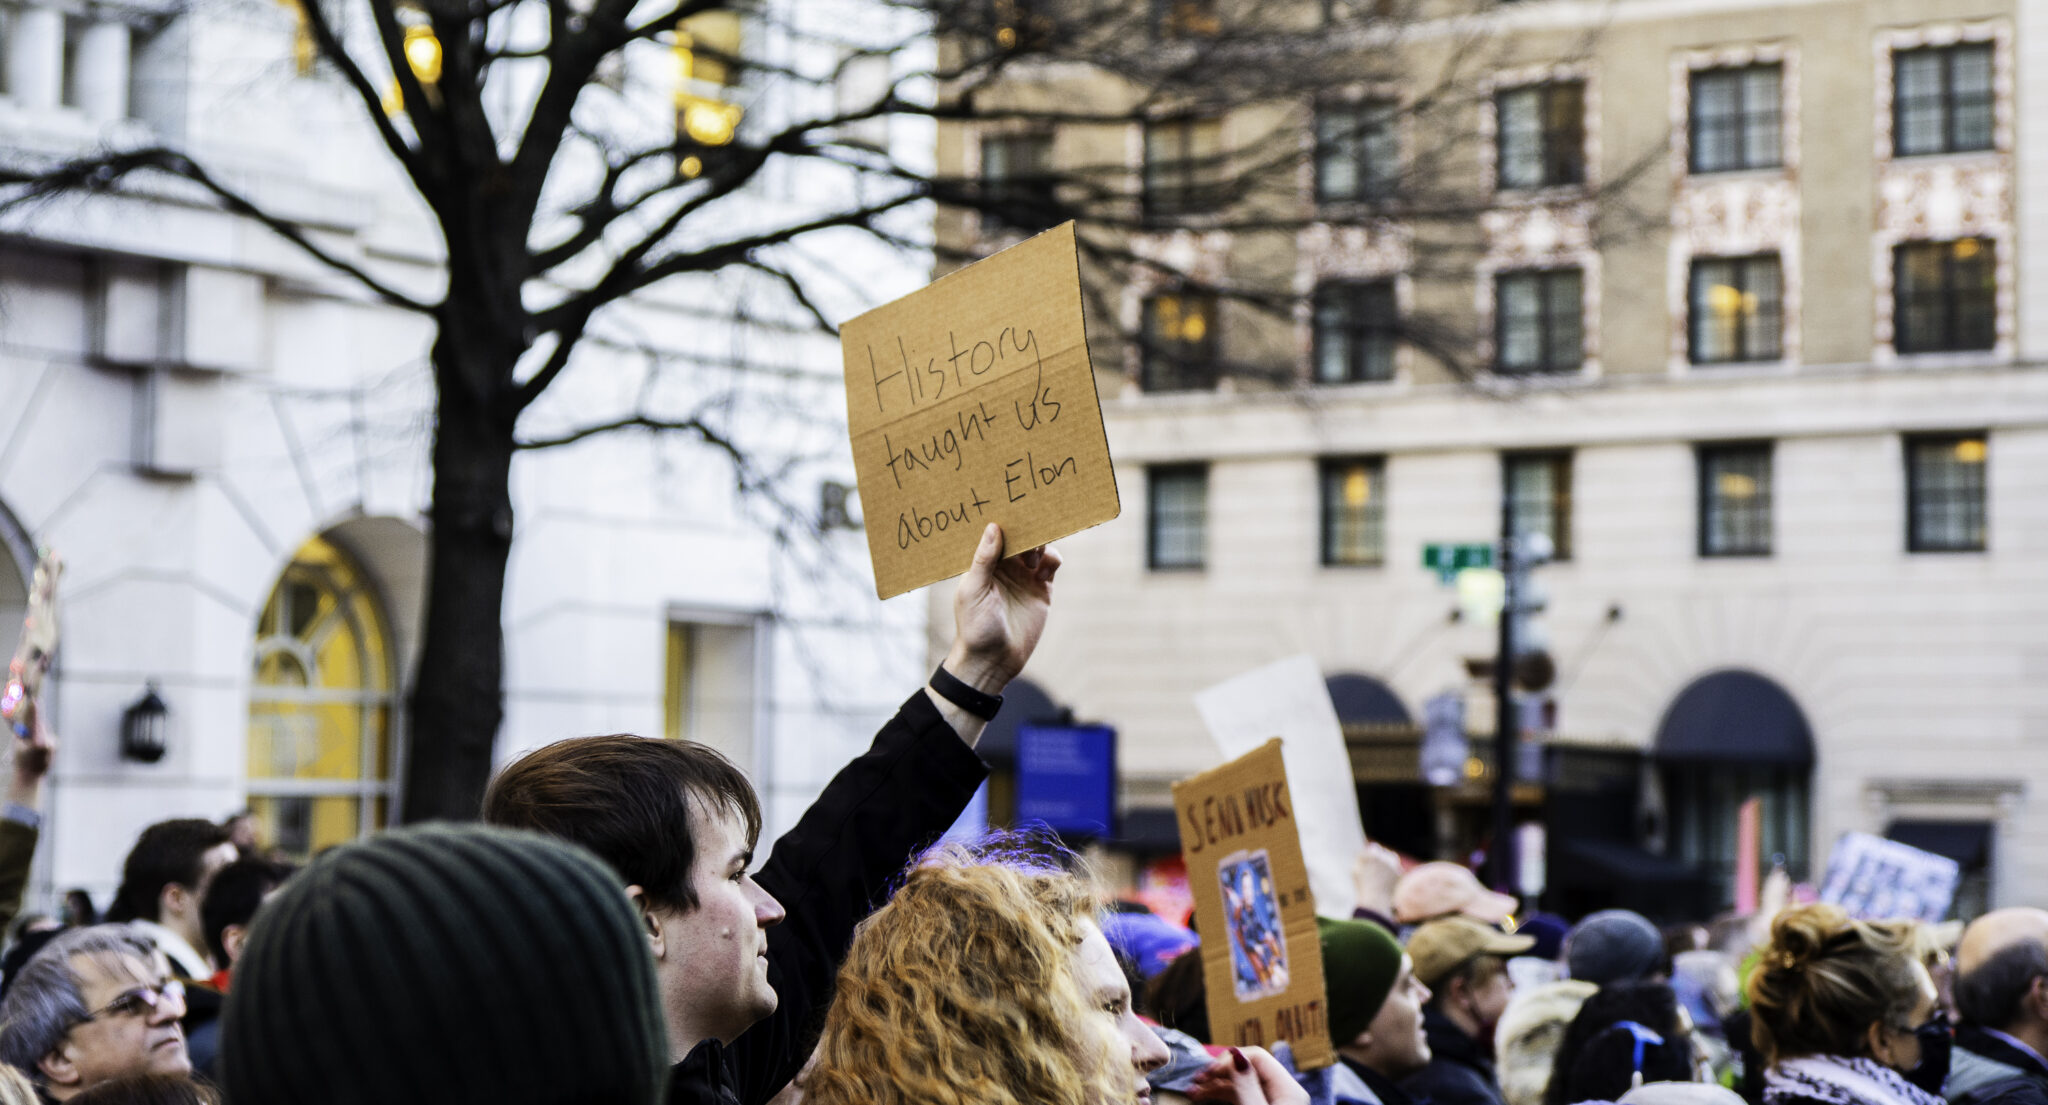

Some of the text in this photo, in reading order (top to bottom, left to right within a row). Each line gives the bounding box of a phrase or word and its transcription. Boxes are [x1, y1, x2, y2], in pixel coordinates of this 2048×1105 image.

[867, 327, 1042, 412] History
[885, 387, 1061, 490] taught us
[898, 452, 1077, 550] about Elon
